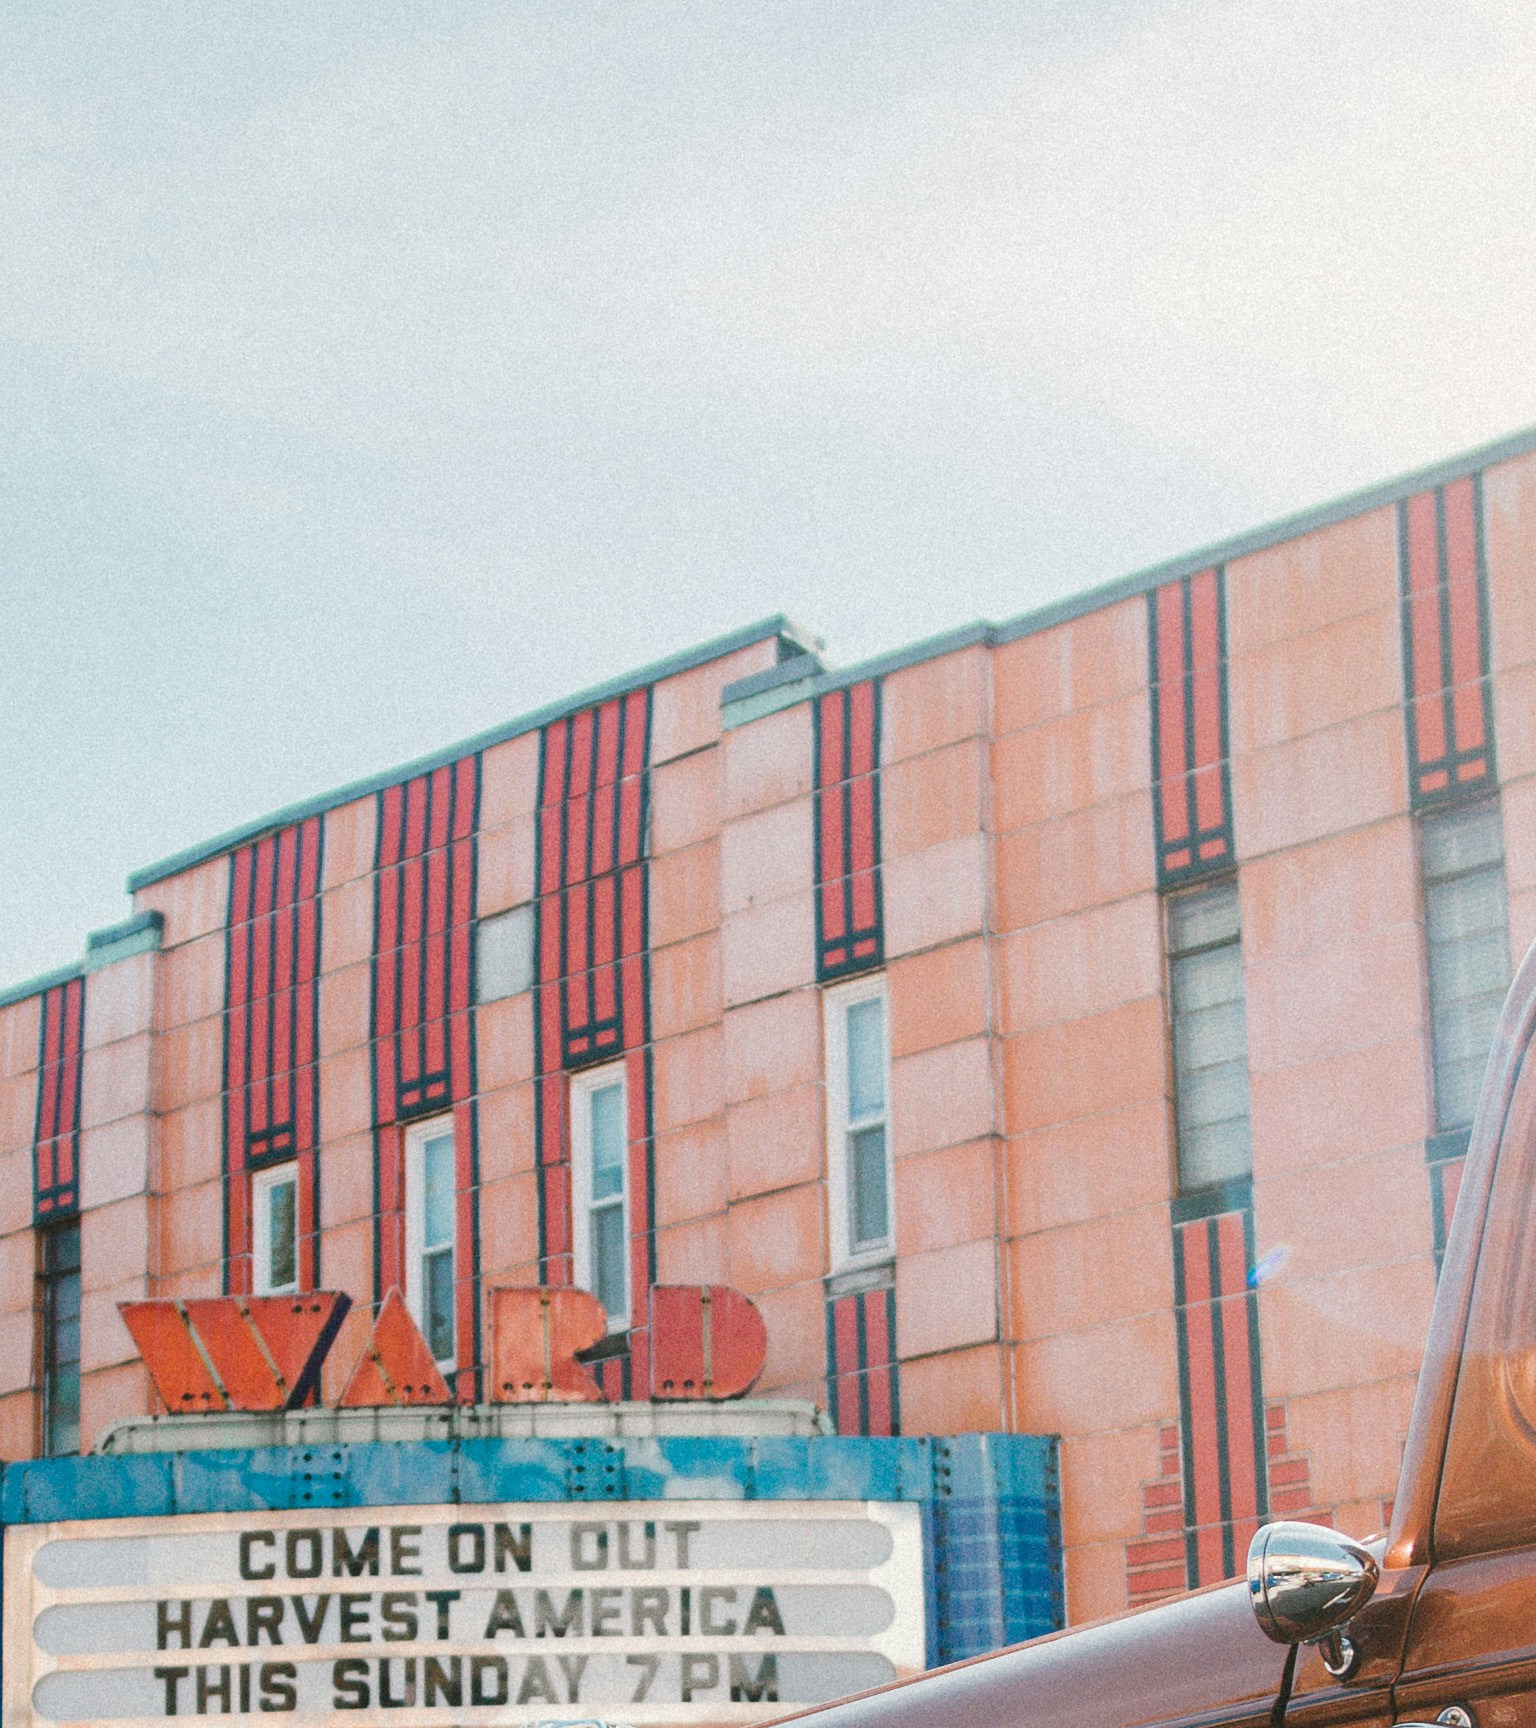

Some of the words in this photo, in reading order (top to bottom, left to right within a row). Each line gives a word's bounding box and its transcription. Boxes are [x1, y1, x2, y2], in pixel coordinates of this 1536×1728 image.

[118, 1283, 769, 1413] WARD
[239, 1526, 423, 1580] COME
[447, 1522, 532, 1574] ON
[570, 1520, 701, 1571] OUT
[156, 1589, 462, 1651] HARVEST
[483, 1586, 787, 1640] AMERICA
[154, 1660, 297, 1716] THIS
[332, 1653, 589, 1711] SUNDAY
[626, 1654, 661, 1703] 7
[680, 1652, 779, 1704] PM
